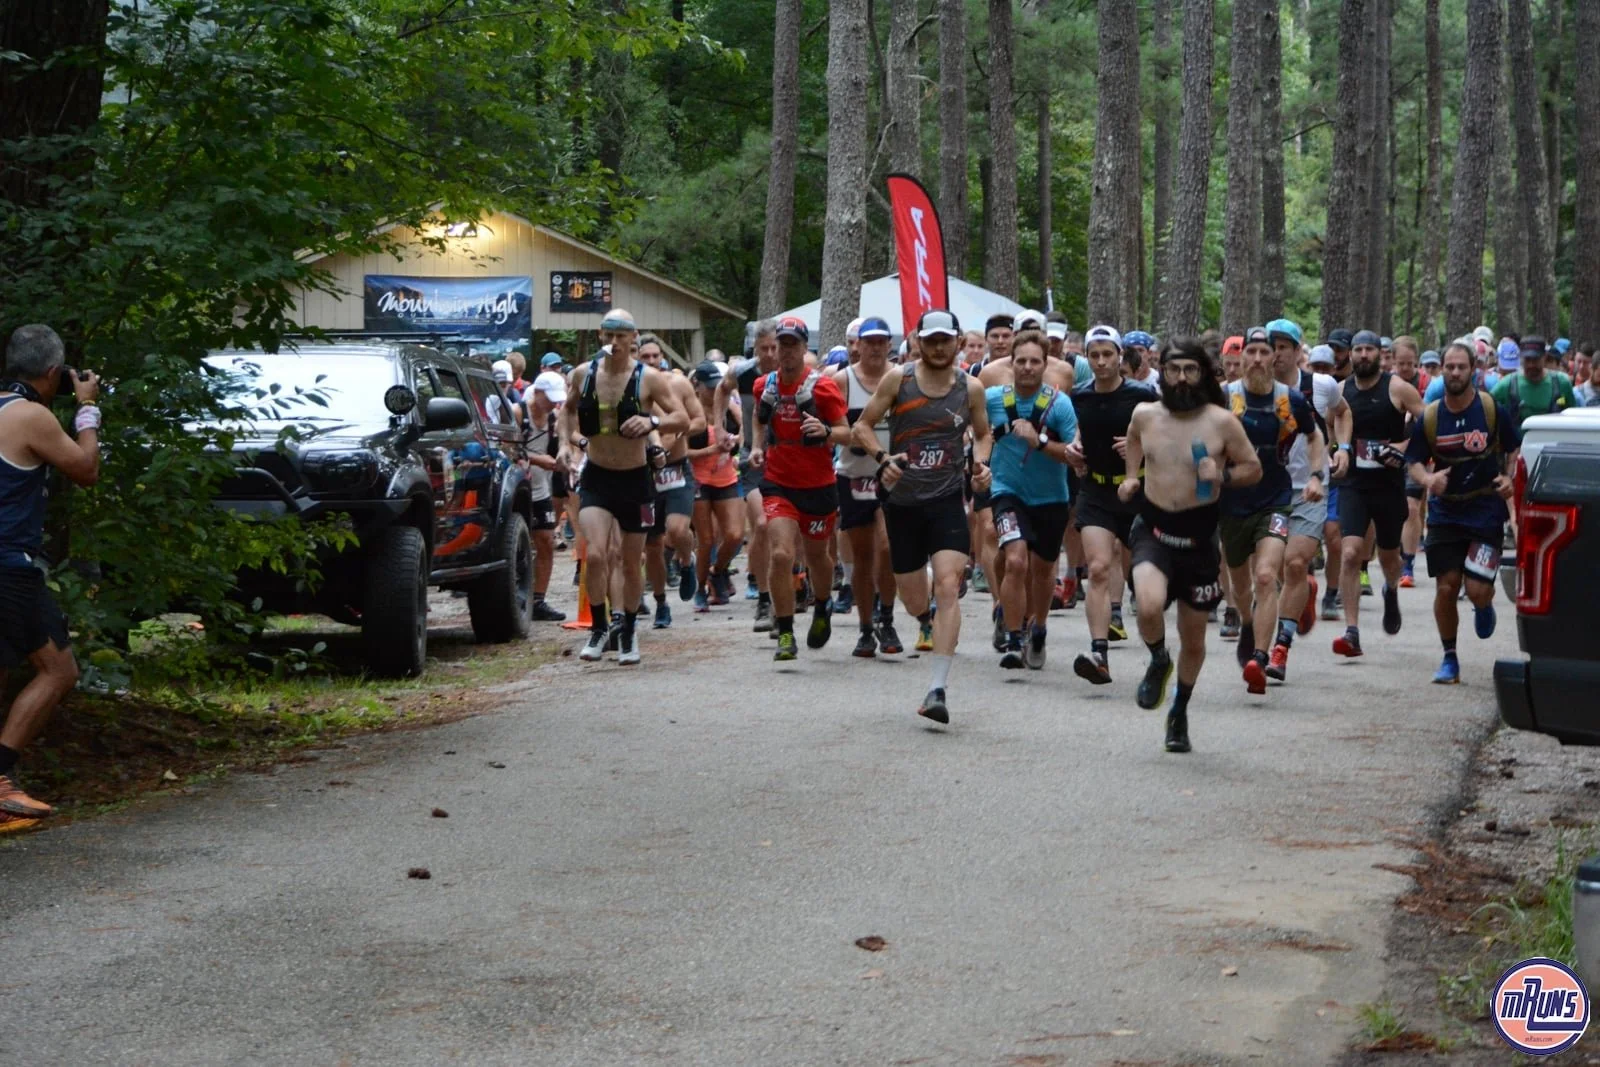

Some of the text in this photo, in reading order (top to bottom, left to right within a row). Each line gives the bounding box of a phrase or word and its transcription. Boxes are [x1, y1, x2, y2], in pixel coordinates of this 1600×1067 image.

[919, 449, 945, 467] 287
[1274, 518, 1283, 532] 2
[1195, 581, 1219, 603] 291
